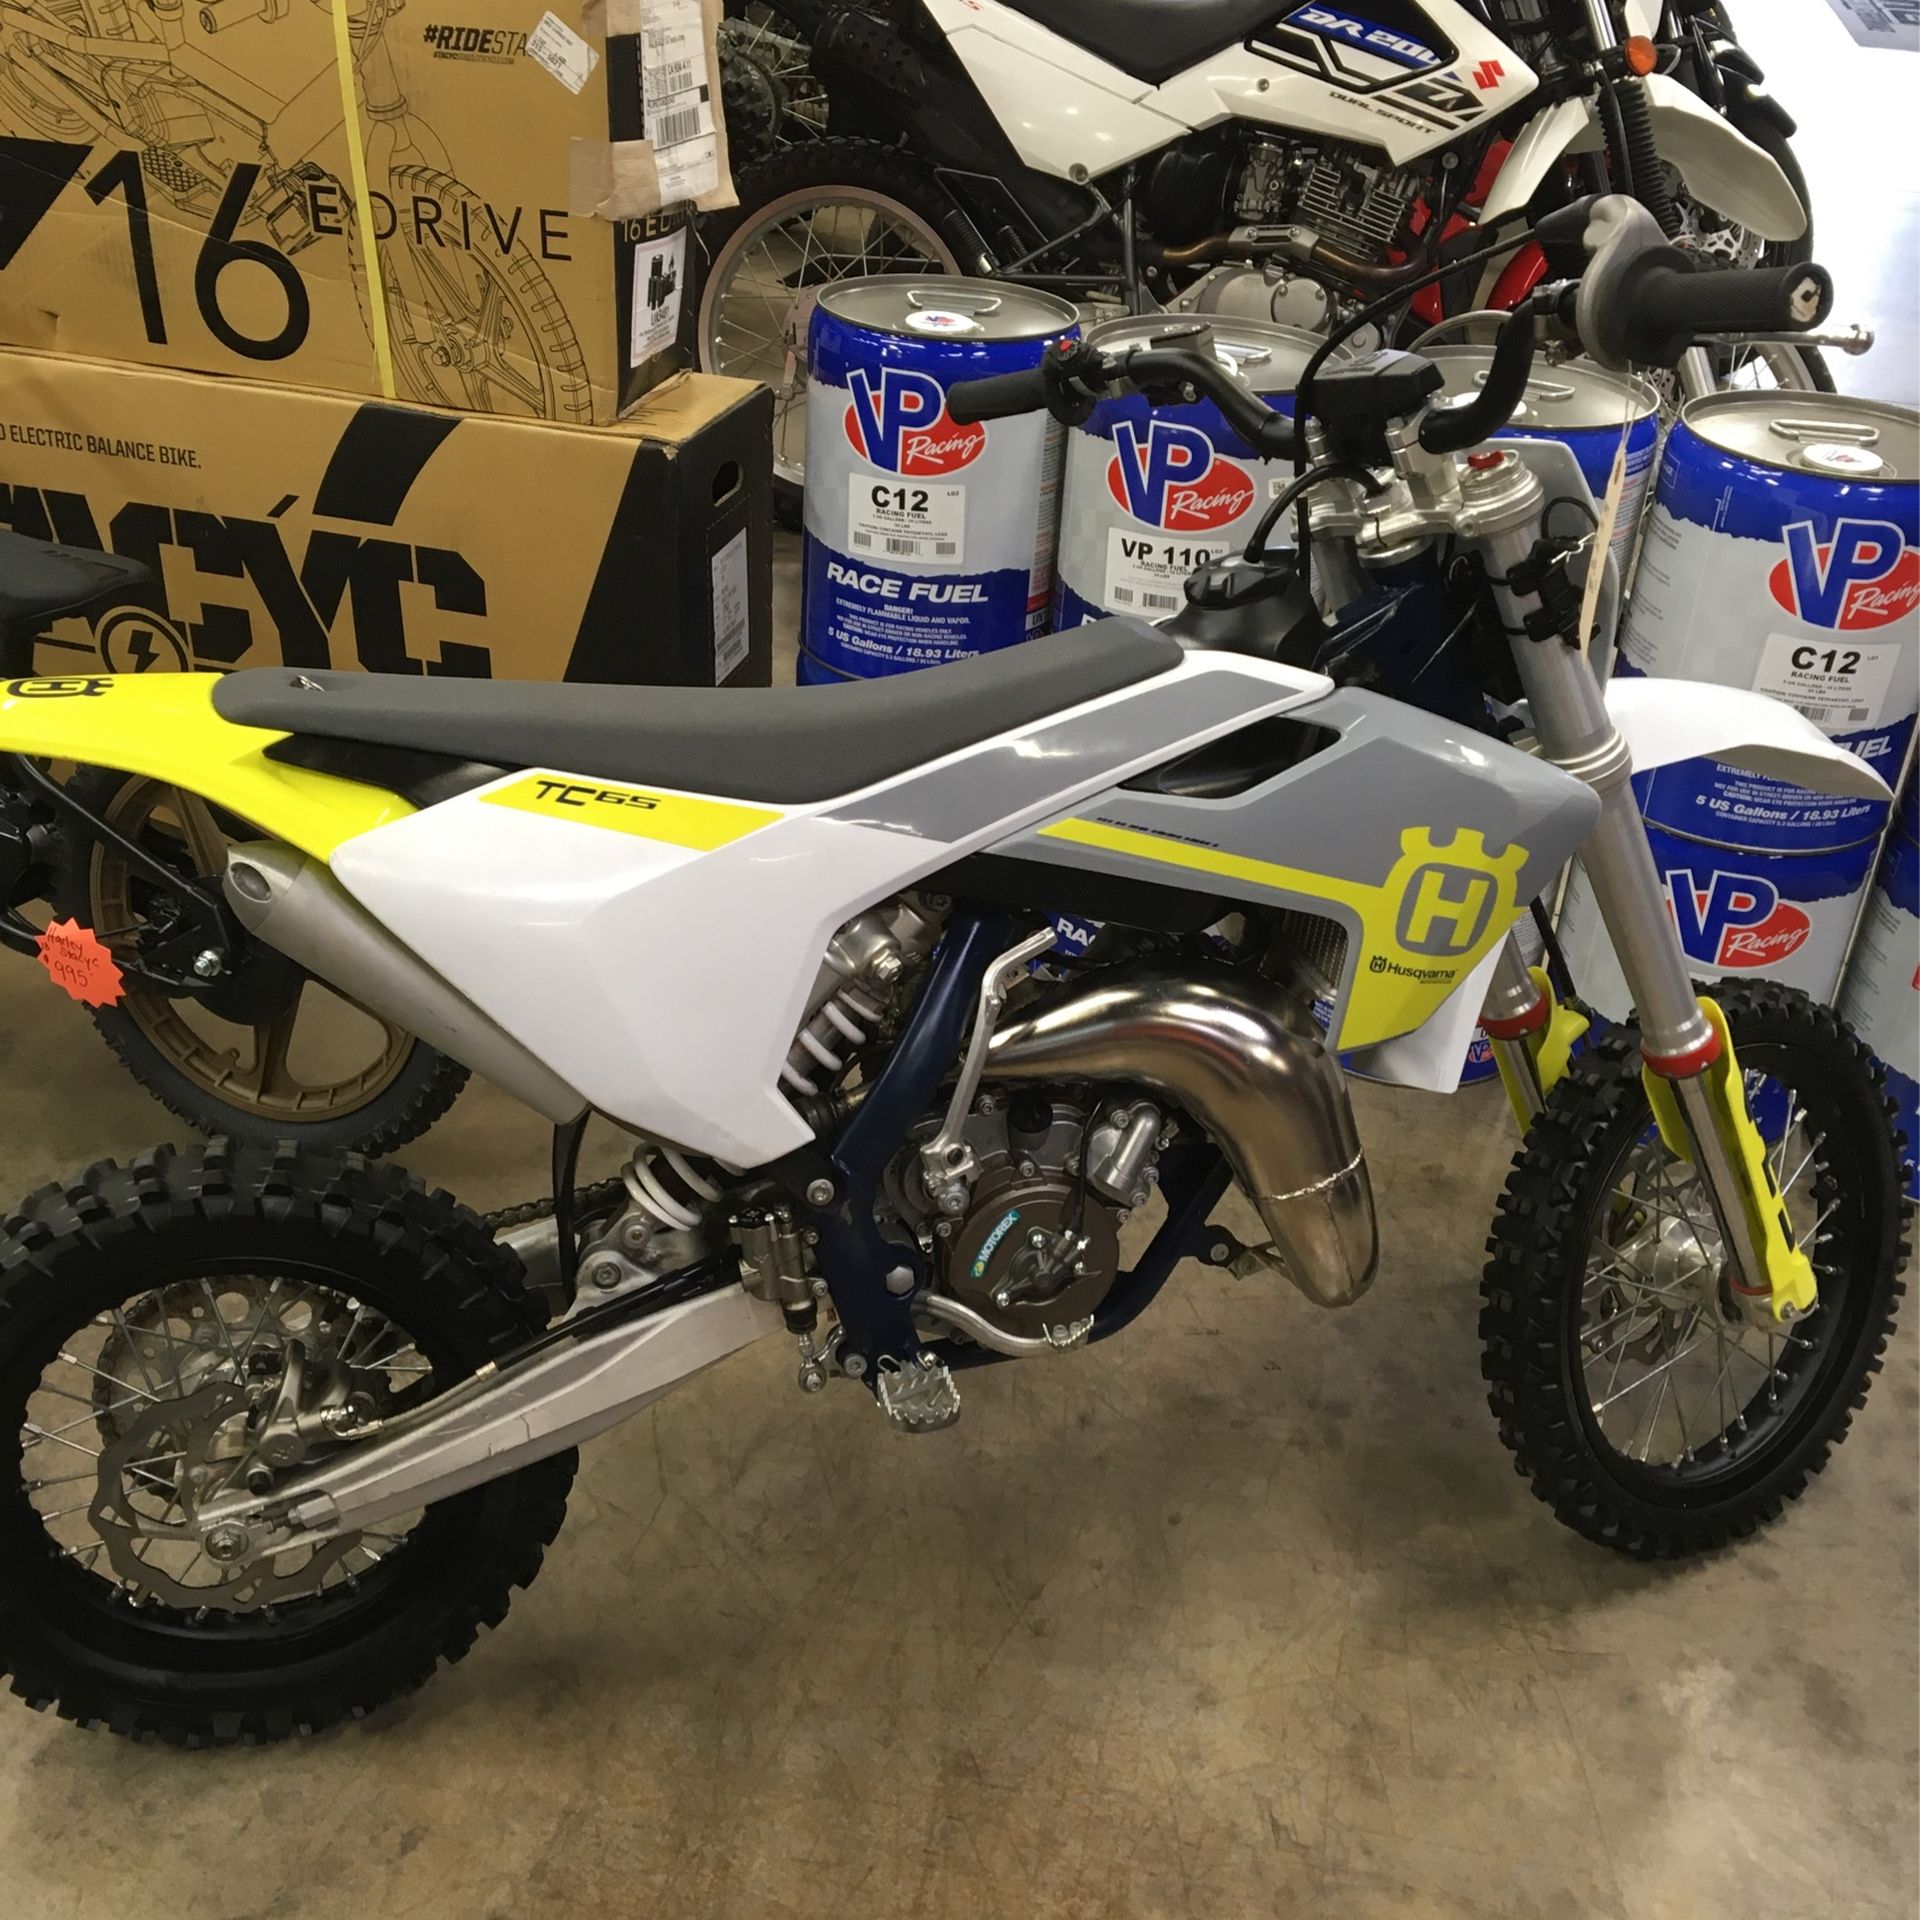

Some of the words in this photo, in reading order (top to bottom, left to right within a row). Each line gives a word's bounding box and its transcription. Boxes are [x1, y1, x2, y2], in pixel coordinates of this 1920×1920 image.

[423, 24, 533, 57] #RIDESTA
[84, 150, 310, 361] 16
[846, 366, 946, 474] VP
[907, 432, 985, 465] Racing
[10, 424, 83, 452] ELECTRIC
[86, 434, 156, 463] BALANCE
[158, 445, 202, 470] BIKE.
[1111, 419, 1215, 530] VP
[1170, 486, 1254, 521] Racing
[871, 485, 929, 513] C12
[876, 508, 905, 518] RACING
[906, 511, 927, 520] FUEL
[1121, 537, 1153, 561] VP
[1163, 546, 1211, 568] 110
[1140, 560, 1168, 570] RACING
[826, 561, 903, 599] RACE
[908, 582, 989, 604] FUEL
[1782, 517, 1906, 630] VP
[1847, 580, 1920, 620] Racing
[836, 596, 867, 613] EXTREMELY
[867, 607, 906, 622] FLAMMABLE
[907, 613, 930, 624] LIQUID
[930, 616, 946, 624] AND
[828, 626, 835, 636] 5
[836, 629, 850, 642] US
[851, 635, 893, 653] Gallons
[906, 647, 942, 659] 18.93
[1791, 646, 1862, 675] C12
[1790, 671, 1826, 682] RACING
[1828, 675, 1850, 684] FUEL
[1836, 735, 1893, 760] UEL
[536, 780, 662, 810] TC65
[1695, 794, 1708, 806] 5
[1709, 797, 1731, 811] US
[1733, 803, 1789, 820] Gallons
[1803, 809, 1840, 821] 18.93
[1840, 803, 1872, 819] Liters
[1057, 917, 1096, 948] RA
[1665, 868, 1780, 966] VP
[1726, 928, 1810, 959] Racing
[1387, 962, 1458, 981] Husqvarna
[978, 1213, 1019, 1262] MOTOREX
